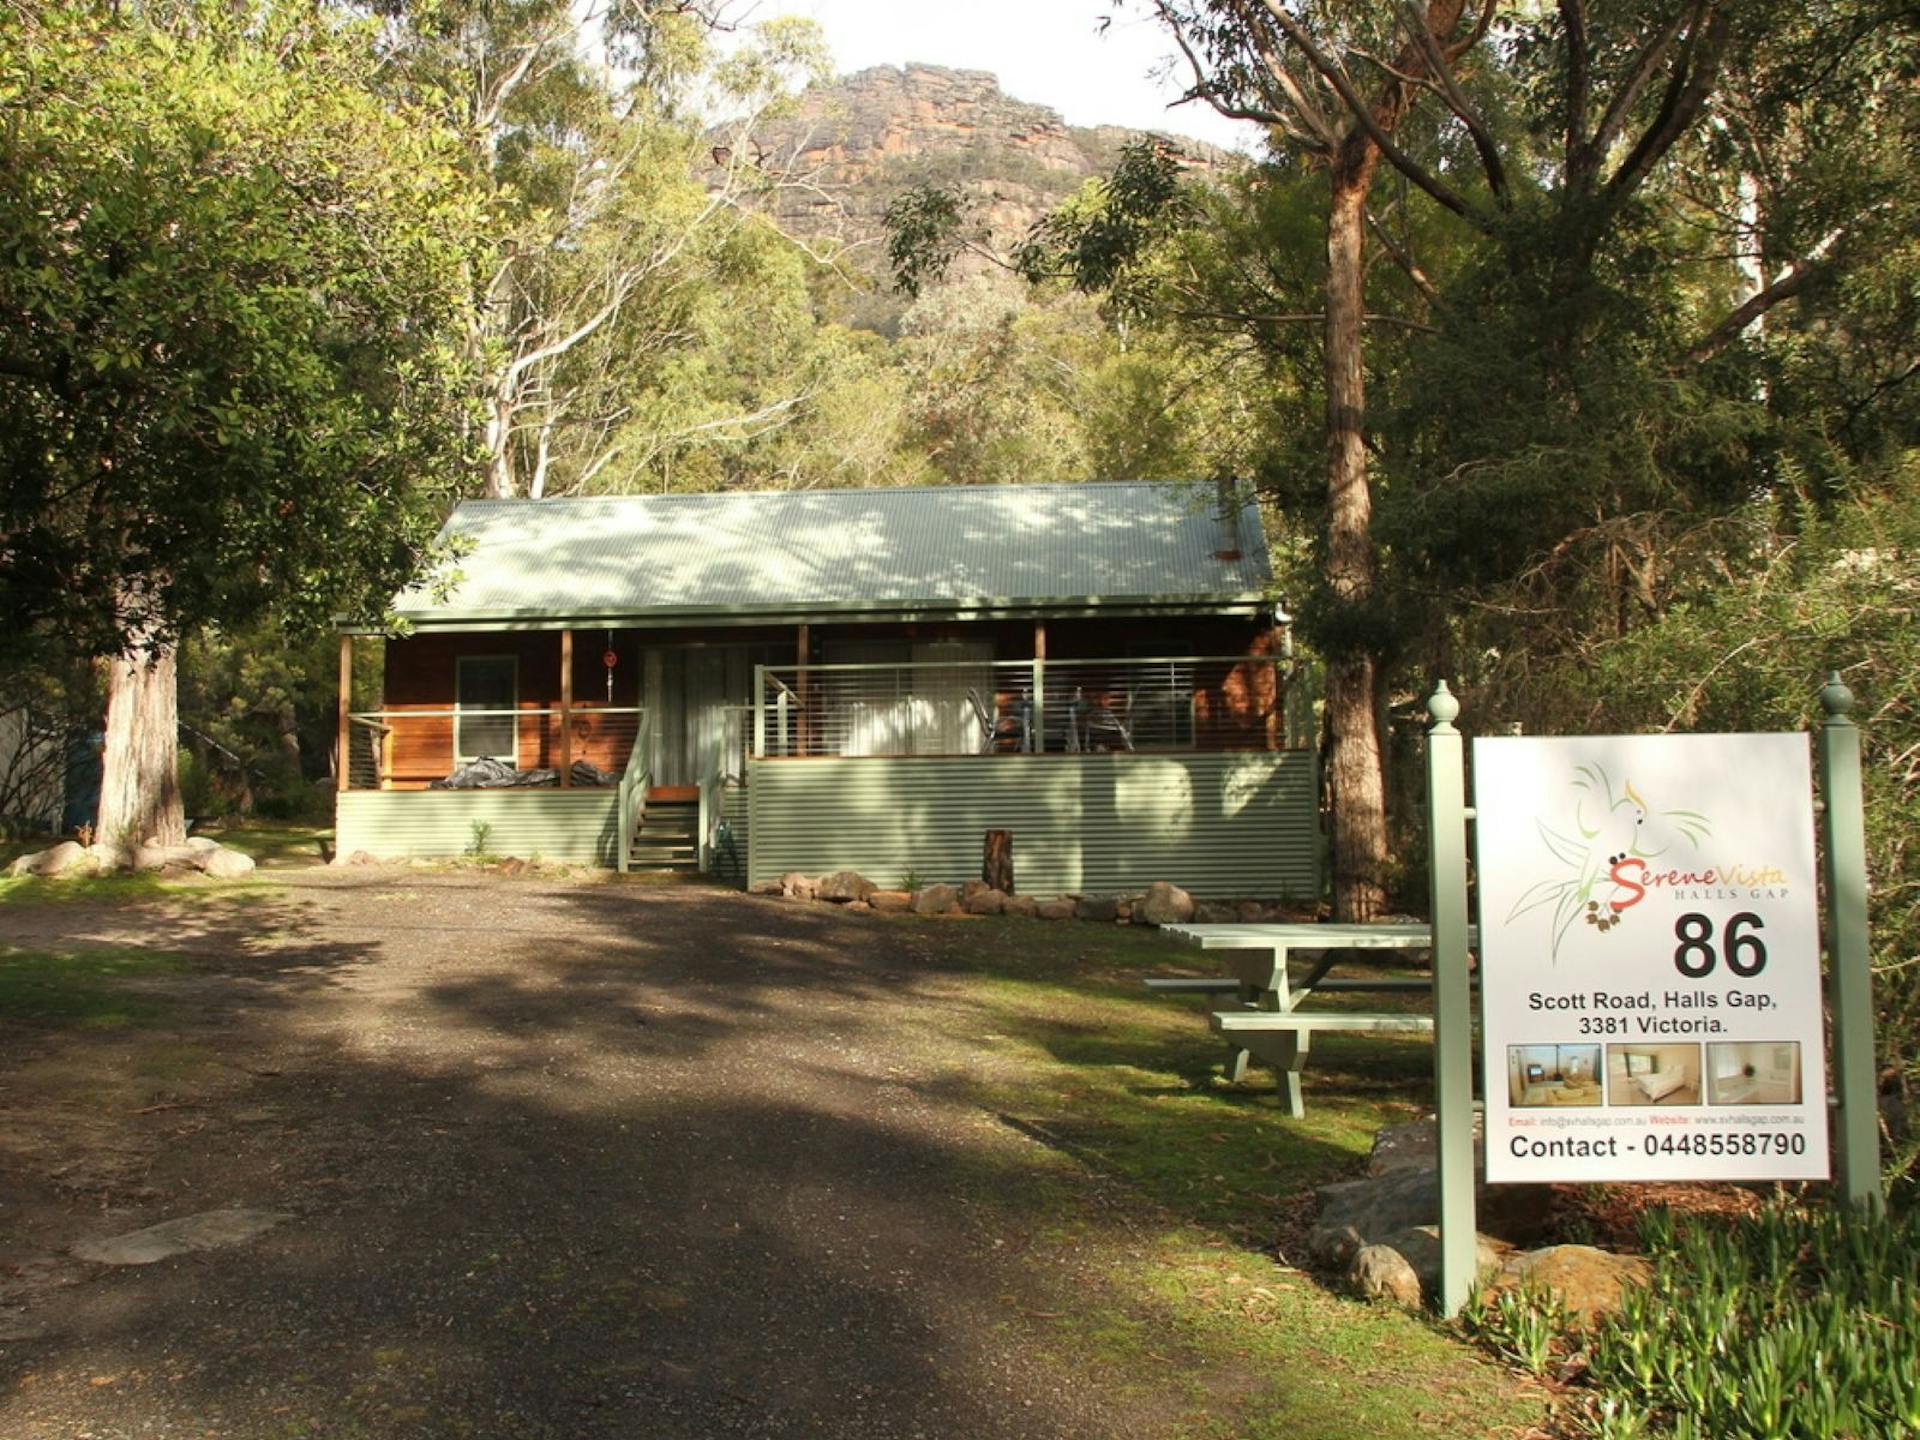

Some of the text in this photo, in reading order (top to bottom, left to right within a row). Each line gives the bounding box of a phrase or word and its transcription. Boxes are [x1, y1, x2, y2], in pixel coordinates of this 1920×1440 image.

[1675, 887, 1790, 900] HALLS GAP
[1674, 912, 1767, 978] 86
[1528, 990, 1777, 1011] Scott Road, Halls Gap,
[1579, 1016, 1728, 1034] 3381 Victoria.
[1508, 1117, 1536, 1127] Email:
[1649, 1116, 1690, 1126] Website:
[1510, 1135, 1617, 1157] Contact
[1644, 1133, 1806, 1156] 0448558790
